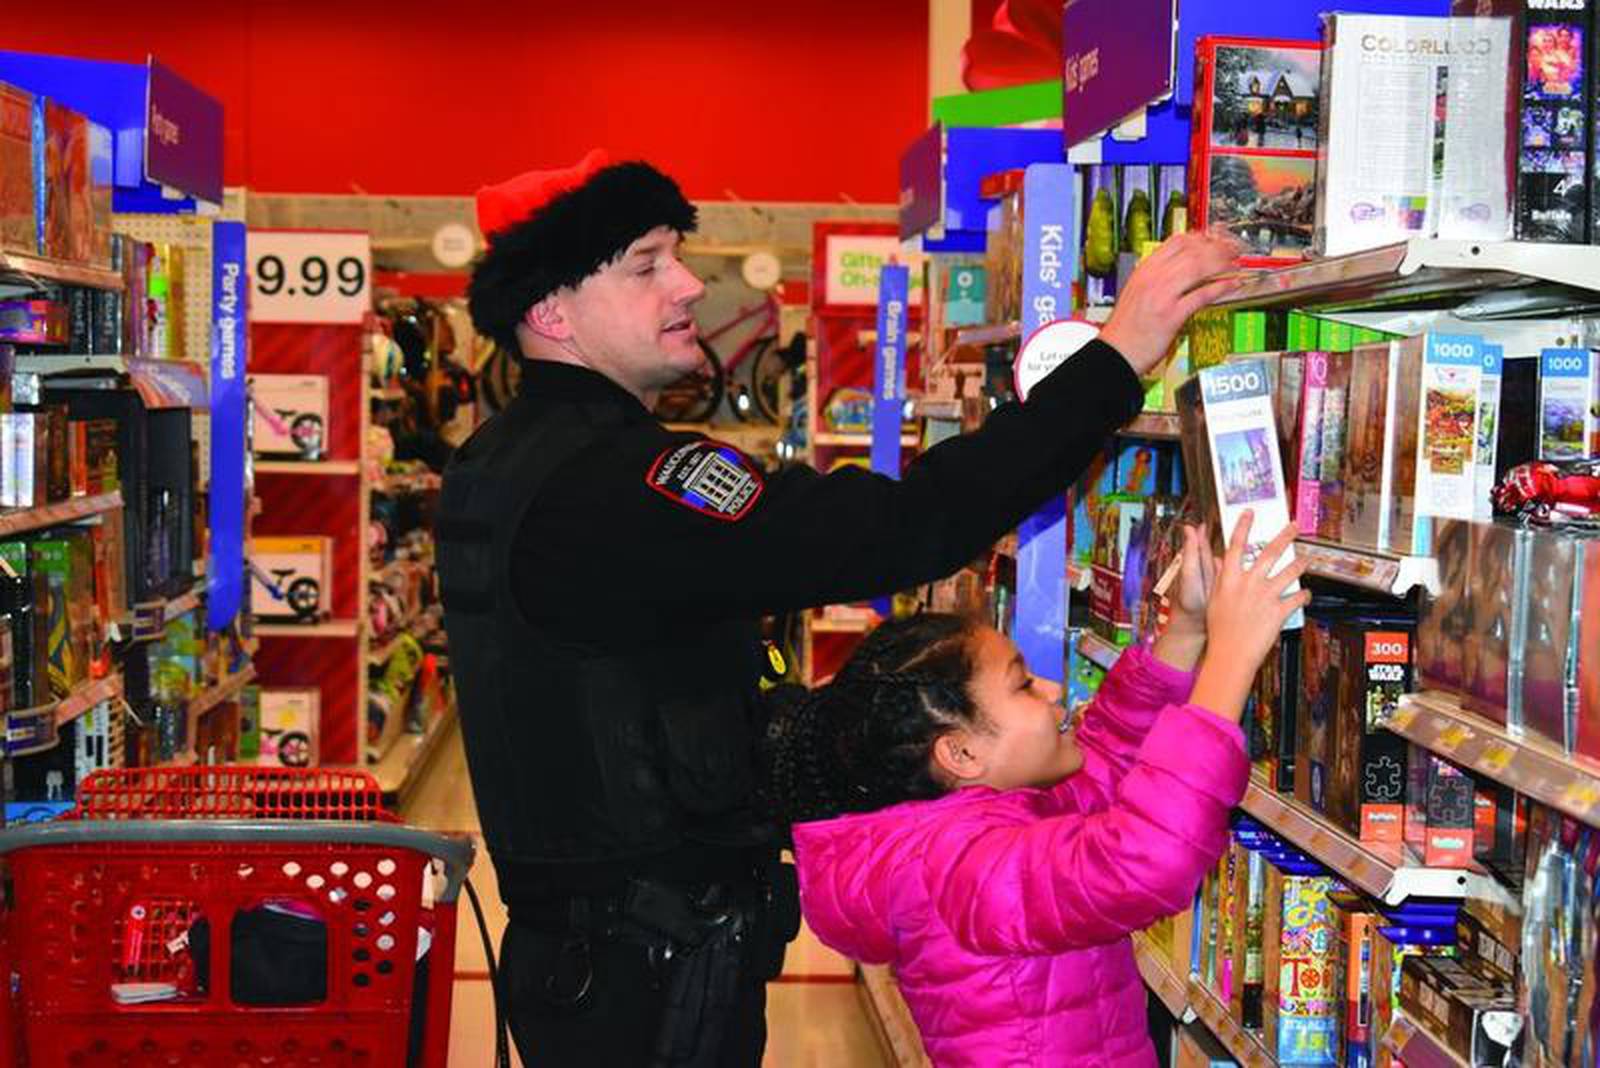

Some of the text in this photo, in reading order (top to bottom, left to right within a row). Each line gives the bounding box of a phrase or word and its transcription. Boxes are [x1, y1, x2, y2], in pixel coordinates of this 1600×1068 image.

[1040, 224, 1063, 289] Kids'
[256, 254, 365, 297] 9.99
[218, 263, 240, 379] Party games
[881, 300, 902, 400] Brain games
[1433, 343, 1474, 358] 1000
[1548, 356, 1584, 371] 1000
[1206, 371, 1261, 397] 1500
[1371, 642, 1403, 656] 300
[1368, 664, 1404, 672] STAR
